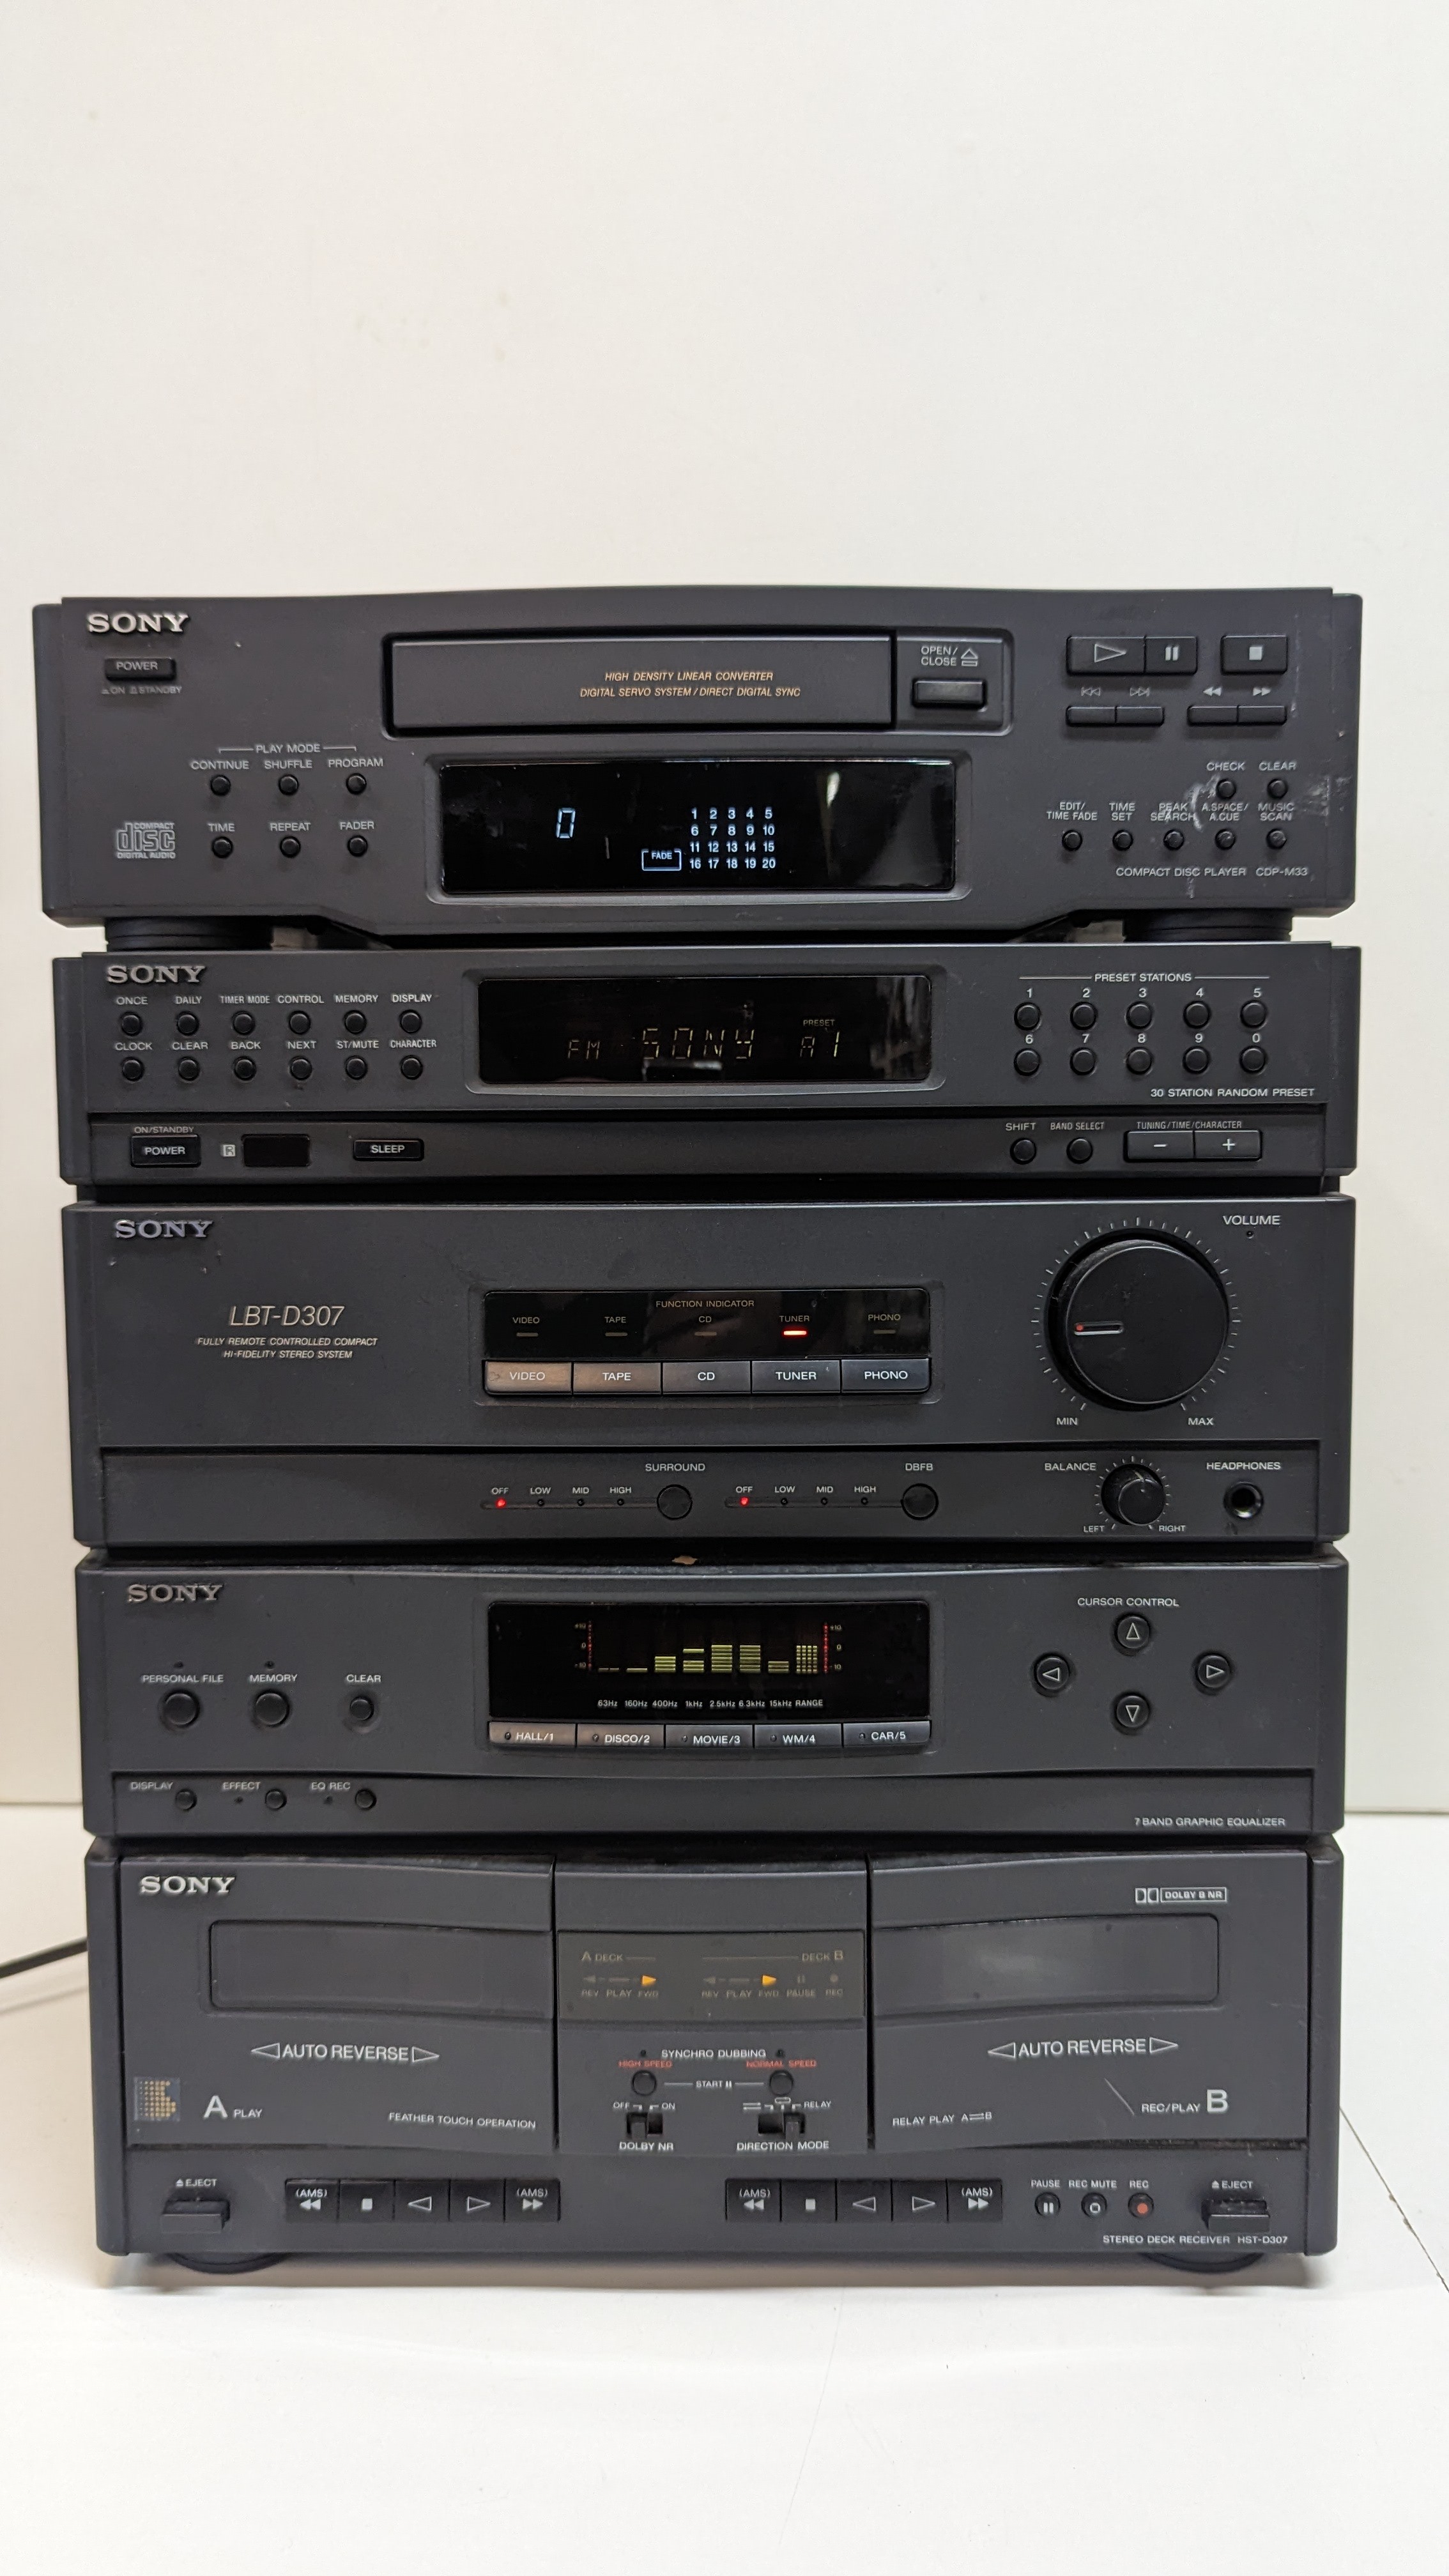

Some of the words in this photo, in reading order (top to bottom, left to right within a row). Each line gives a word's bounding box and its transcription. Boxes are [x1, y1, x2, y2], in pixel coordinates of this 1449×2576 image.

[87, 612, 188, 633] SONY
[116, 661, 158, 671] POWER
[921, 657, 956, 666] CLOSE
[604, 672, 629, 682] HIGH
[633, 671, 674, 681] DENSITY
[677, 671, 712, 681] LINEAR
[716, 671, 774, 681] CONVERTER
[580, 687, 615, 698] DIGITAL
[618, 687, 652, 697] SERVO
[737, 687, 772, 696] DIGITAL
[775, 687, 801, 697] SYNC
[255, 744, 283, 754] PLAY
[286, 743, 320, 753] MODE
[190, 760, 249, 770] CONTINUE
[264, 759, 312, 769] SHUFFLE
[328, 758, 383, 768] PROGRAM
[1206, 761, 1245, 771] CHECK
[1259, 761, 1297, 771] CLEAR
[1109, 802, 1135, 811] TIME
[1257, 802, 1295, 811] MUSIC
[1111, 812, 1131, 821] SET
[1260, 813, 1292, 821] SCAN
[207, 822, 235, 832] TIME
[270, 822, 311, 832] REPEAT
[339, 820, 374, 830] FADER
[1116, 867, 1171, 877] COMPACT
[1174, 867, 1200, 877] DISC
[1204, 867, 1246, 877] PLAYER
[1255, 867, 1308, 877] CDP-M33
[106, 963, 205, 983] SONY
[1094, 973, 1137, 982] PRESET
[1139, 972, 1192, 982] STATIONS
[1027, 988, 1032, 998] 1
[1082, 988, 1091, 998] 2
[1138, 987, 1147, 998] 3
[1195, 988, 1204, 997] 4
[1254, 987, 1262, 998] 5
[116, 996, 148, 1006] ONCE
[174, 995, 202, 1004] DAILY
[220, 995, 245, 1004] TIMER
[247, 995, 270, 1004] MODE
[277, 995, 325, 1004] CONTROL
[335, 994, 379, 1003] MEMORY
[392, 993, 432, 1003] DISPLAY
[114, 1041, 153, 1051] CLOCK
[171, 1041, 208, 1050] CLEAR
[230, 1041, 261, 1050] BACK
[287, 1040, 316, 1050] NEXT
[337, 1039, 379, 1049] ST/MUTE
[390, 1039, 437, 1048] CHARACTER
[1151, 1088, 1165, 1098] 30
[1168, 1088, 1213, 1098] STATION
[1217, 1088, 1268, 1097] RANDOM
[1272, 1088, 1315, 1097] PRESET
[134, 1126, 194, 1134] ON/STANDBY
[1006, 1122, 1036, 1131] SHIFT
[1050, 1122, 1073, 1130] BAND
[1075, 1121, 1105, 1130] SELECT
[144, 1146, 185, 1156] POWER
[371, 1144, 405, 1154] SLEEP
[1223, 1215, 1280, 1225] VOLUME
[114, 1219, 212, 1238] SONY
[706, 1300, 755, 1308] INDICATOR
[230, 1305, 345, 1326] LBT-D307
[197, 1337, 225, 1346] FULLY
[227, 1337, 266, 1346] REMOTE
[269, 1337, 331, 1346] CONTROLLED
[334, 1337, 378, 1346] COMPACT
[223, 1349, 276, 1358] HI-FIDELITY
[279, 1350, 315, 1359] STEREO
[317, 1350, 353, 1359] SYSTEM
[509, 1372, 546, 1381] VIDEO
[602, 1372, 631, 1381] TAPE
[697, 1372, 716, 1381] CD
[776, 1371, 816, 1381] TUNER
[864, 1370, 908, 1380] PHONO
[1056, 1417, 1078, 1425] MIN
[1188, 1417, 1214, 1425] MAX
[645, 1463, 705, 1472] SURROUND
[905, 1462, 933, 1471] DBFB
[1044, 1462, 1096, 1471] BALANCE
[1206, 1461, 1282, 1470] HEADPHONES
[530, 1487, 551, 1495] LOW
[610, 1486, 632, 1494] HIGH
[126, 1583, 222, 1603] SONY
[1077, 1597, 1123, 1606] CURSOR
[1126, 1597, 1179, 1607] CONTROL
[141, 1675, 199, 1683] PERSONAL
[202, 1674, 224, 1683] FILE
[249, 1674, 298, 1683] MEMORY
[346, 1674, 381, 1683] CLEAR
[795, 1699, 823, 1707] RANGE
[514, 1731, 554, 1741] HALL/1
[604, 1734, 650, 1744] DISCO/2
[693, 1735, 740, 1744] MOVIE/3
[782, 1735, 815, 1744] WM/4
[871, 1731, 906, 1741] CAR/5
[130, 1781, 173, 1791] DISPLAY
[222, 1781, 261, 1791] EFFECT
[1176, 1817, 1223, 1827] GRAPHIC
[1227, 1818, 1285, 1827] EQUALIZER
[140, 1876, 235, 1895] SONY
[1018, 2041, 1064, 2057] AUTO
[1067, 2038, 1146, 2055] REVERSE
[282, 2044, 328, 2058] AUTO
[331, 2044, 409, 2062] REVERSE
[661, 2050, 714, 2058] SYNCHRO
[717, 2049, 766, 2058] DUBBING
[804, 2101, 831, 2109] RELAY
[1141, 2103, 1200, 2113] REC/PLAY
[1207, 2089, 1229, 2113] B
[203, 2095, 228, 2119] A
[233, 2109, 263, 2118] PLAY
[388, 2112, 434, 2123] FEATHER
[438, 2115, 473, 2126] TOUCH
[477, 2118, 536, 2129] OPERATION
[893, 2116, 925, 2126] RELAY
[929, 2115, 954, 2124] PLAY
[618, 2142, 655, 2152] DOLBY
[657, 2142, 674, 2151] NR
[737, 2142, 793, 2151] DIRECTION
[797, 2140, 829, 2150] MODE
[185, 2178, 217, 2187] EJECT
[1031, 2179, 1060, 2188] PAUSE
[1068, 2179, 1088, 2188] REC
[1091, 2180, 1117, 2189] MUTE
[1129, 2180, 1149, 2189] REC
[296, 2188, 328, 2198] (AMS)
[1103, 2235, 1144, 2244] STEREO
[1147, 2235, 1176, 2244] DECK
[1179, 2235, 1230, 2244] RECEIVER
[1238, 2235, 1288, 2244] HST-D307
